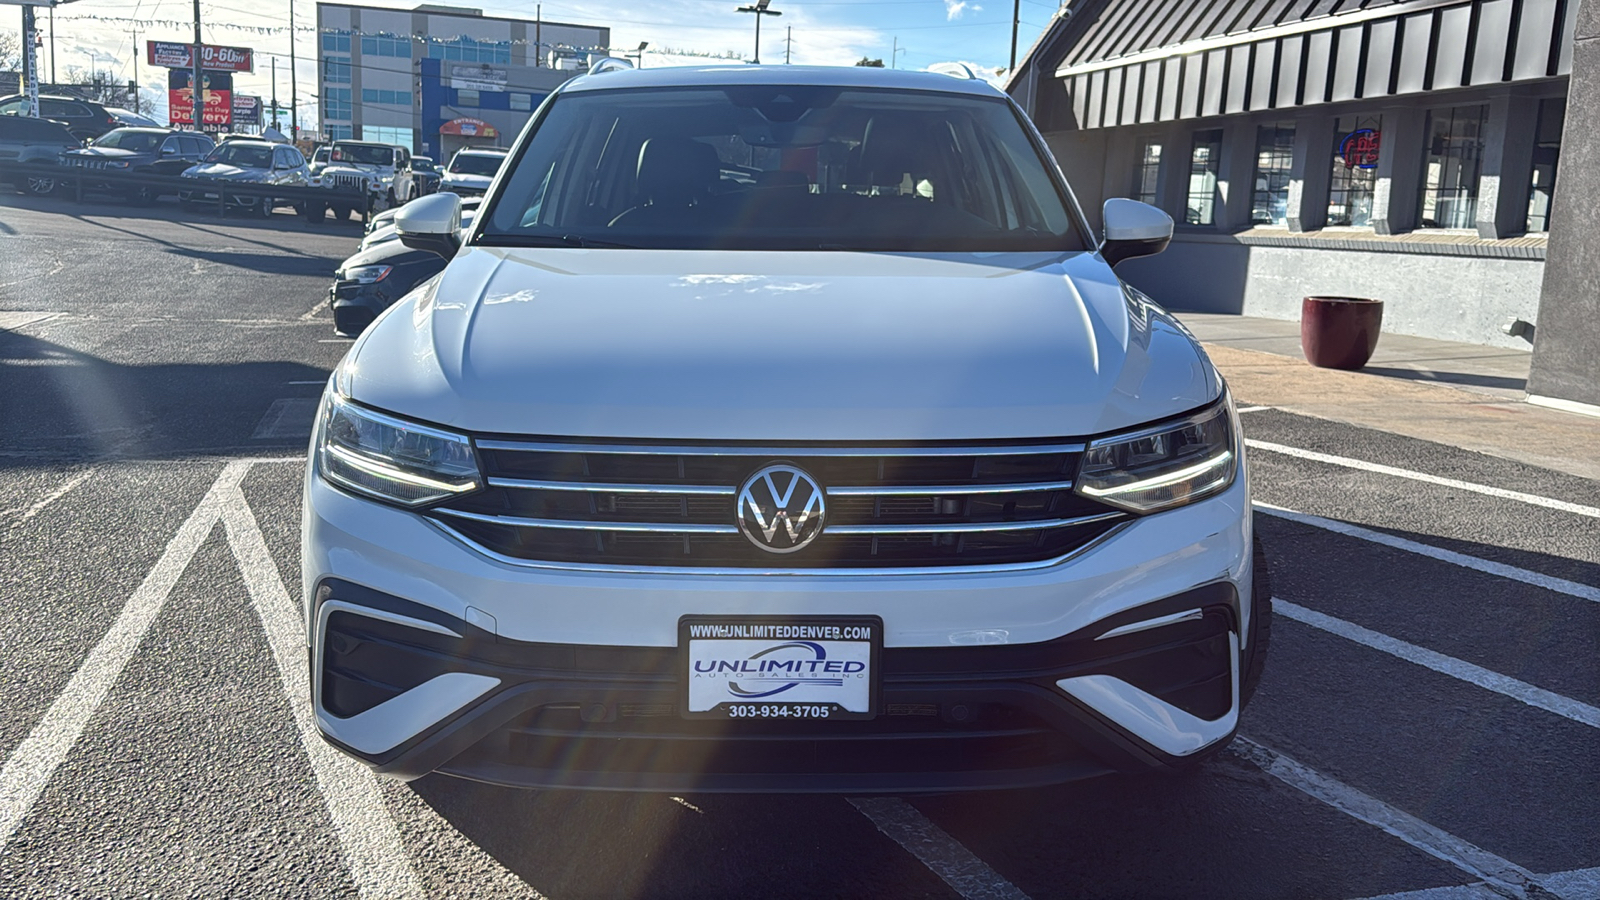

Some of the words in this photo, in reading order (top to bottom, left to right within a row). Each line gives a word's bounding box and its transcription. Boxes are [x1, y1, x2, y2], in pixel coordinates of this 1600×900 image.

[214, 106, 229, 114] Day
[171, 110, 228, 124] Delery
[453, 118, 485, 126] ENTRANCE
[173, 122, 229, 133] Avaable
[689, 624, 871, 640] WWWUNLIMITEDDENVE.COM
[694, 660, 866, 673] UNLIMITED
[729, 705, 829, 718] 303-934-3705
